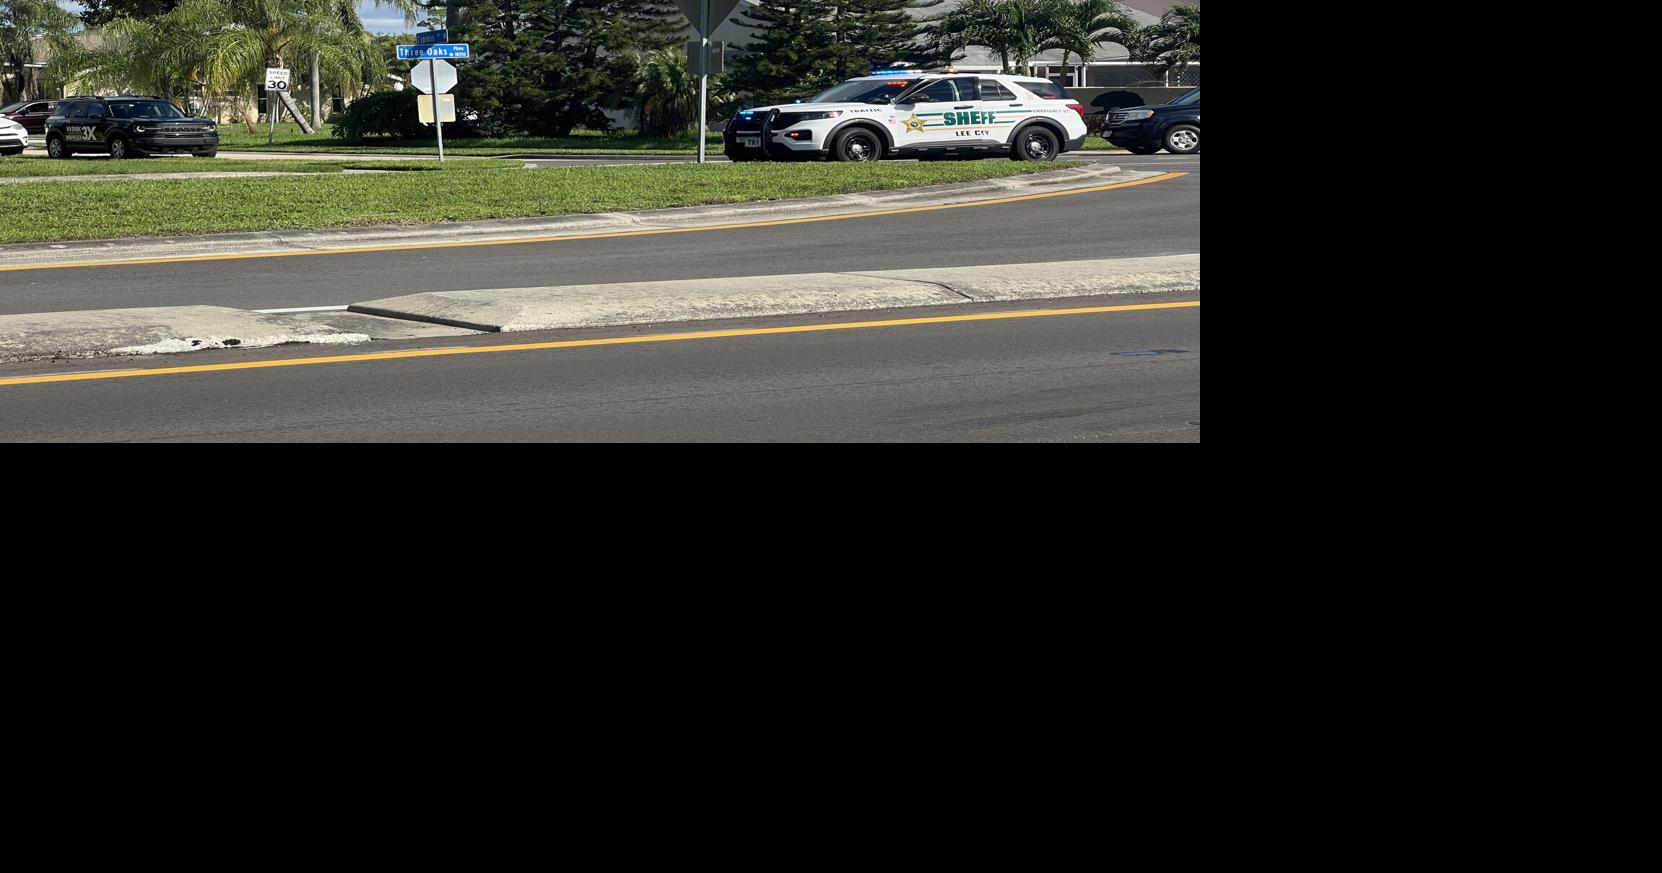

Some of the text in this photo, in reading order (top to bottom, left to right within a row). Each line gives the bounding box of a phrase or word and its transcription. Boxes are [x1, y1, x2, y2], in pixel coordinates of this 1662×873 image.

[399, 48, 424, 57] Three
[427, 47, 448, 56] Oaks
[267, 80, 287, 89] 30
[81, 126, 97, 141] 3X
